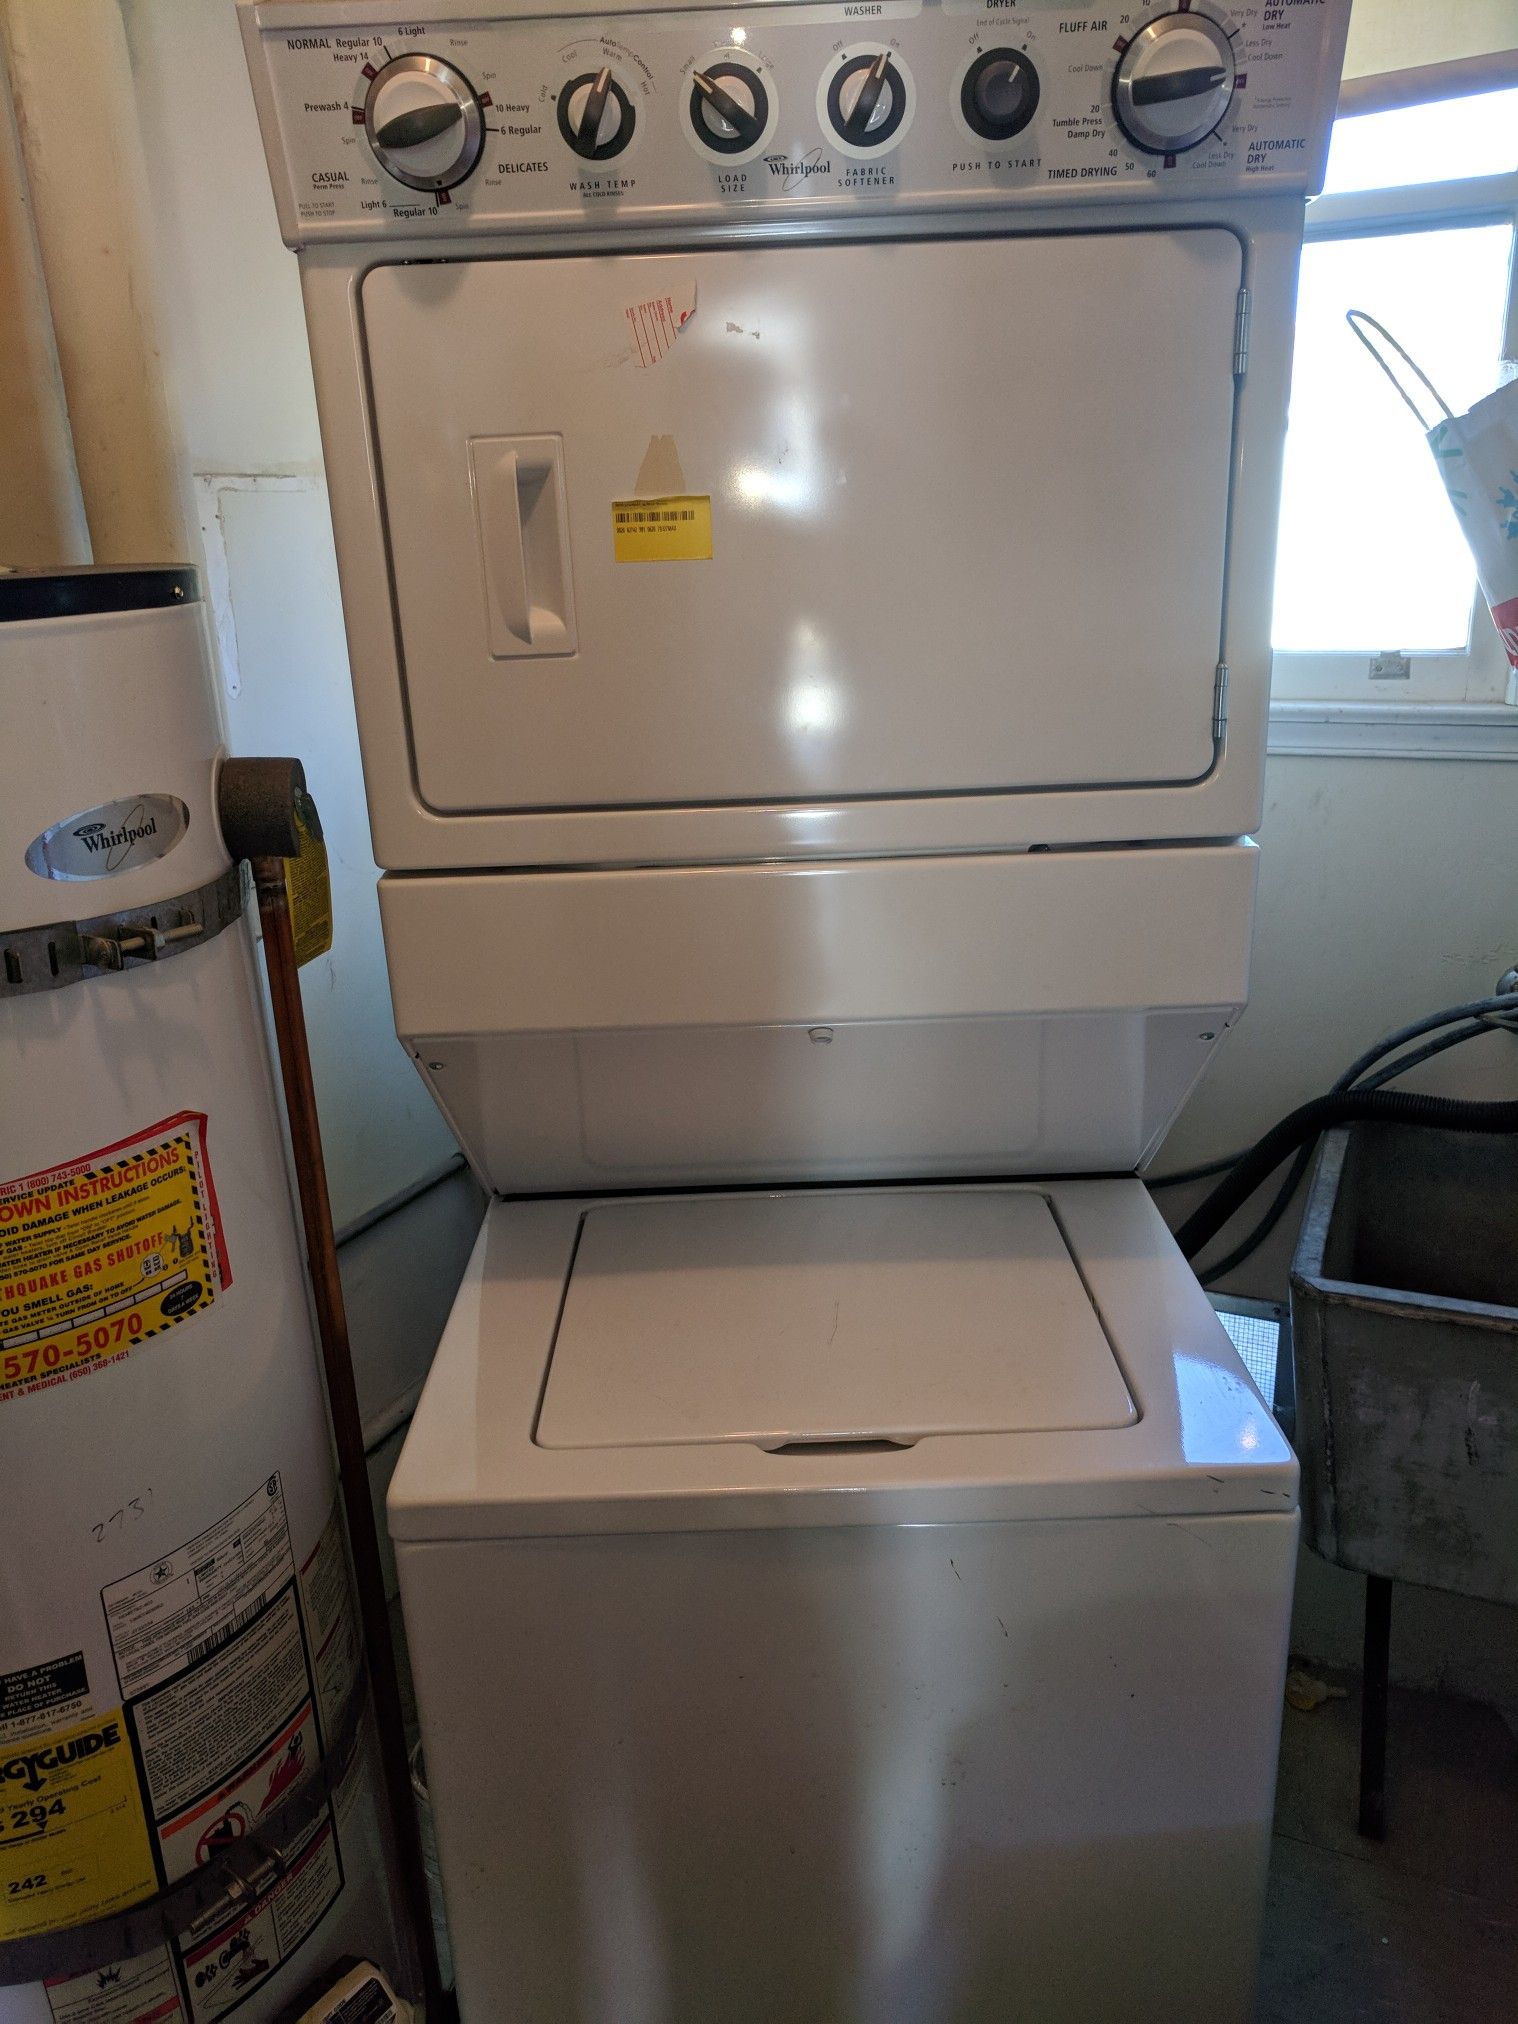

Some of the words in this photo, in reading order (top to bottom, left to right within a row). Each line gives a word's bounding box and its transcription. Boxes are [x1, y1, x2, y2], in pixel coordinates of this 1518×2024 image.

[844, 5, 882, 16] WASHER
[986, 0, 1016, 9] DRYER
[1120, 14, 1130, 23] 20
[1264, 9, 1284, 21] DRY
[398, 27, 403, 35] 6
[405, 26, 426, 37] Light
[1059, 21, 1088, 33] FLUFF
[1090, 20, 1108, 31] AIR
[287, 38, 331, 50] NORMAL
[336, 37, 370, 51] Regular
[373, 36, 382, 46] 10
[333, 53, 357, 63] Heavy
[360, 52, 369, 60] 14
[633, 54, 654, 80] Control
[304, 101, 341, 112] Prewash
[343, 101, 349, 110] 4
[495, 104, 504, 113] 10
[506, 103, 530, 114] Heavy
[1090, 105, 1100, 113] 20
[1053, 118, 1080, 127] Tumble
[1082, 117, 1102, 126] Press
[501, 126, 506, 135] 6
[508, 125, 542, 136] Regular
[1067, 130, 1090, 139] Damp
[1092, 129, 1106, 139] Dry
[1248, 139, 1306, 151] AUTOMATIC
[1109, 148, 1118, 157] 40
[1247, 153, 1267, 164] DRY
[498, 161, 549, 174] DELICATES
[768, 161, 831, 177] Whirlpool
[952, 162, 981, 171] PUSH
[988, 160, 1001, 169] TO
[1008, 159, 1041, 168] START
[1125, 162, 1135, 171] 50
[311, 171, 350, 182] CASUAL
[718, 174, 747, 183] LOAD
[846, 167, 887, 177] FABRIC
[1048, 168, 1078, 179] TIMED
[1080, 166, 1118, 178] DRYING
[570, 181, 600, 191] WASH
[606, 179, 636, 189] TEMP
[720, 184, 745, 193] SIZE
[838, 177, 895, 187] SOFTENER
[361, 200, 380, 211] Light
[382, 200, 387, 208] 6
[393, 208, 426, 219] Regular
[428, 206, 438, 216] 10
[81, 817, 157, 854] Whirlpool
[51, 1163, 91, 1182] 743-5000
[0, 1194, 51, 1222] OWN
[57, 1146, 180, 1208] INSTRUCTIONS
[37, 1178, 75, 1195] UPDATE
[22, 1211, 70, 1231] DAMAGE
[72, 1200, 103, 1216] WHEN
[105, 1182, 149, 1205] LEAKAGE
[150, 1165, 186, 1187] OCCURS:
[5, 1236, 32, 1247] WATER
[33, 1227, 62, 1239] SUPPLY
[23, 1249, 52, 1261] HEATER
[63, 1231, 104, 1249] NECESSARY
[49, 1258, 64, 1267] FOR
[65, 1249, 86, 1262] SAME
[87, 1244, 101, 1254] DAY
[73, 1258, 102, 1279] GAS
[107, 1231, 163, 1266] SHUTOFF
[24, 1294, 63, 1311] SMELL
[67, 1284, 93, 1298] GAS:
[12, 1315, 28, 1323] GAS
[30, 1306, 57, 1318] METER
[59, 1294, 91, 1309] OUTSIDE
[21, 1318, 44, 1328] VALVE
[55, 1308, 76, 1318] TURN
[77, 1300, 97, 1311] FROM
[4, 1312, 143, 1380] 570-5070
[40, 1352, 102, 1379] SPECIALISTS
[17, 1388, 25, 1396] &
[28, 1374, 67, 1393] MEDICAL
[69, 1365, 91, 1381] (650)
[4, 1673, 28, 1684] HAVE
[40, 1655, 82, 1674] PROBLEM
[7, 1684, 24, 1693] DO
[27, 1675, 52, 1688] NOT
[4, 1689, 37, 1702] RETURN
[39, 1683, 57, 1691] THIS
[2, 1698, 30, 1710] WATER
[31, 1689, 62, 1702] HEATER
[7, 1706, 32, 1716] PLACE
[36, 1785, 80, 1804] Operating
[11, 1798, 66, 1829] 294
[8, 1874, 47, 1894] 242
